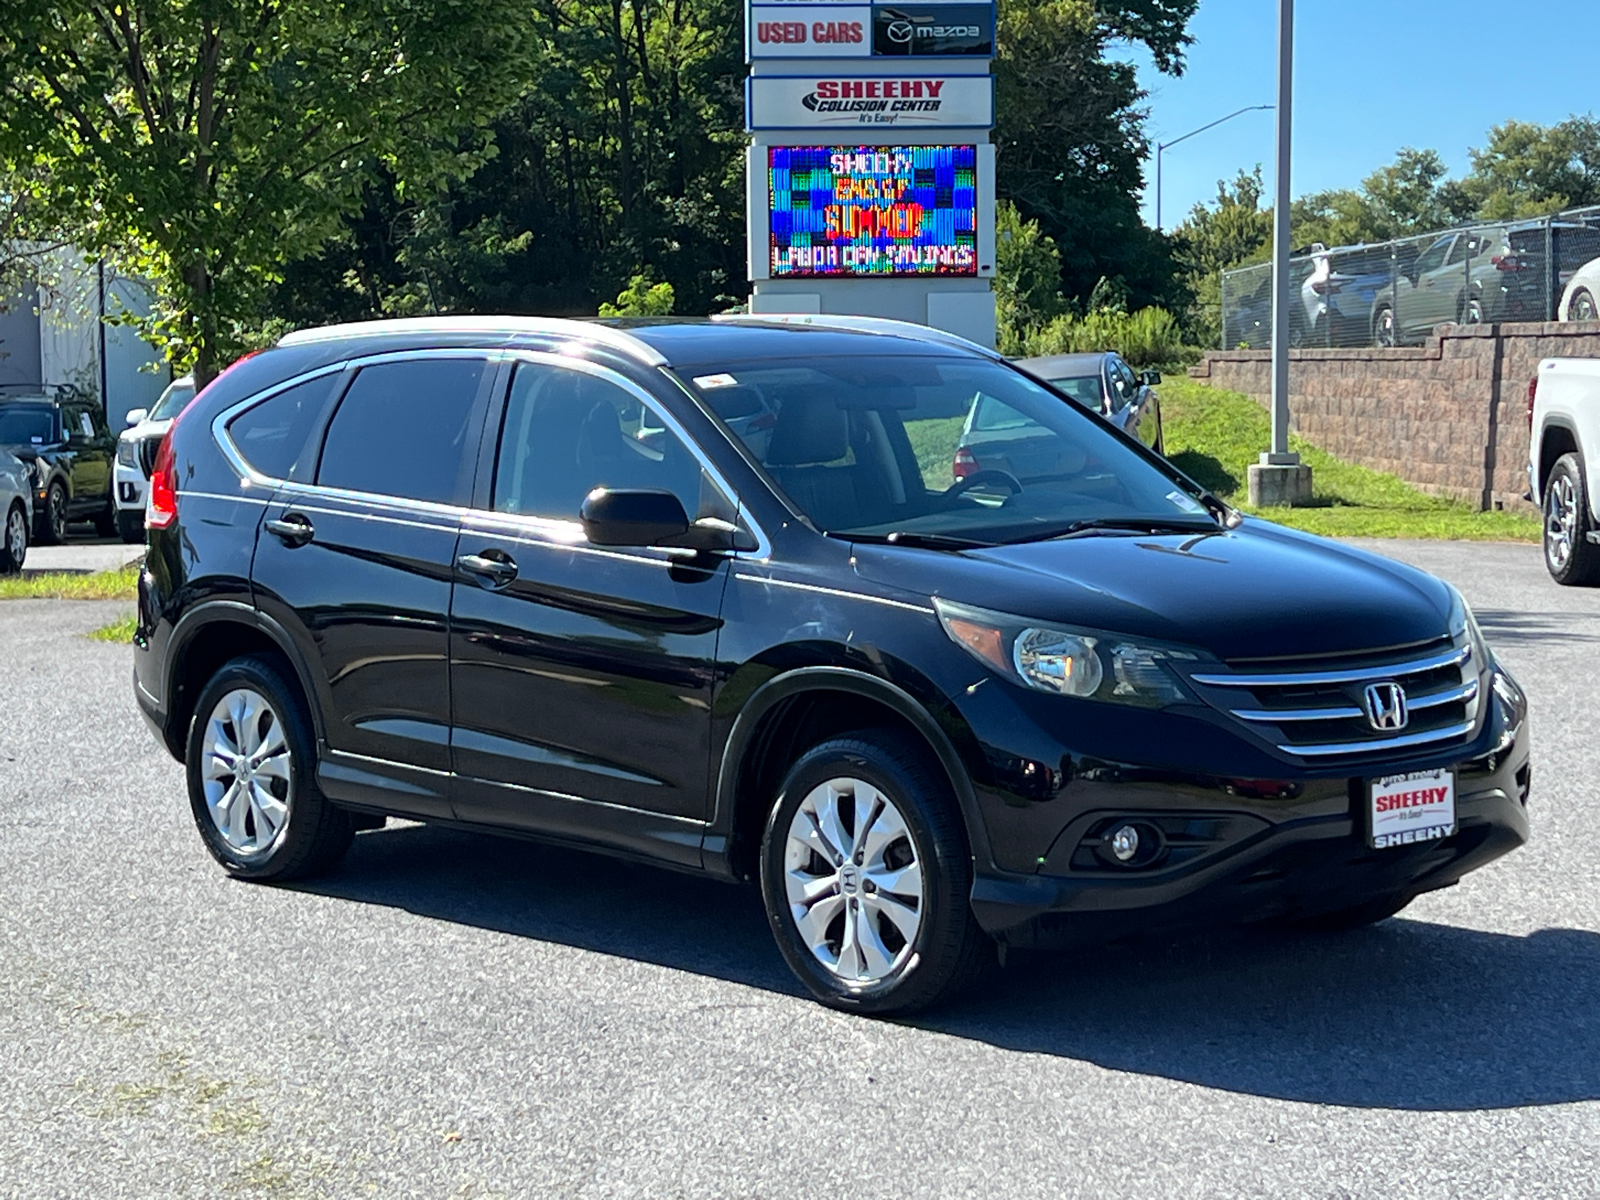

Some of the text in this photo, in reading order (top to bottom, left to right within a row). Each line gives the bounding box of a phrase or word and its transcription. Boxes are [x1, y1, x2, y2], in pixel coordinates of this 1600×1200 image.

[757, 21, 863, 44] USED CARS
[816, 80, 945, 98] SHEEHY
[817, 100, 942, 112] COLLISION CENTER
[859, 113, 873, 123] It's
[1376, 787, 1448, 812] SHEEHY
[1374, 825, 1454, 848] SHEEHY
